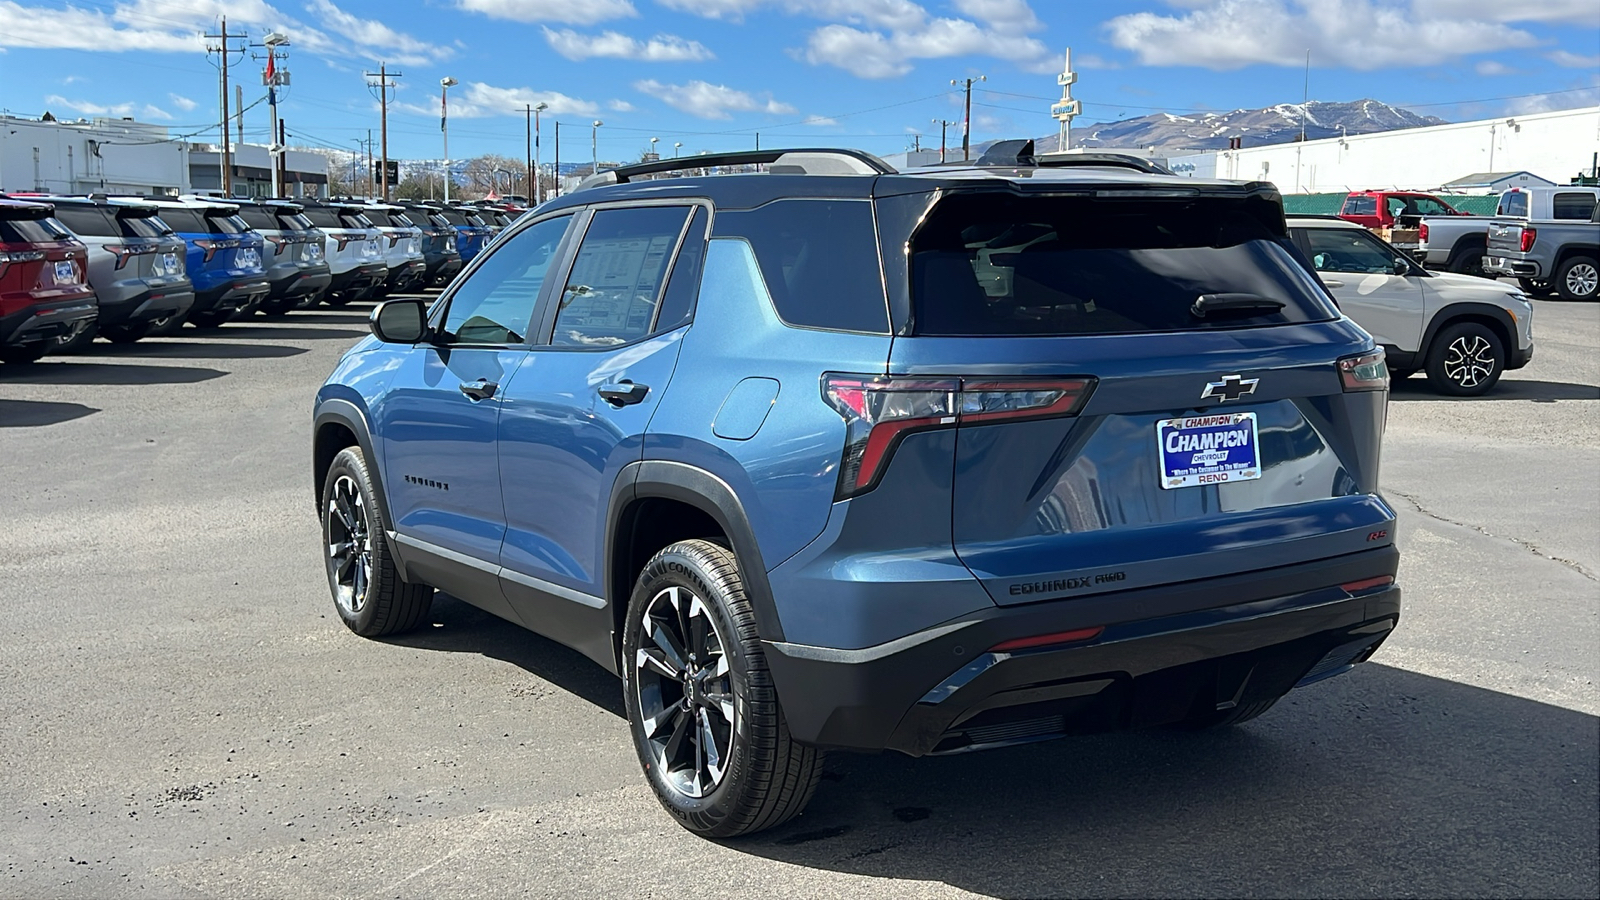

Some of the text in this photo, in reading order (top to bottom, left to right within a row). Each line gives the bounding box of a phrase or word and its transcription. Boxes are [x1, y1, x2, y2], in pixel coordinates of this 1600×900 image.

[1185, 416, 1231, 428] CHAMPION
[1166, 430, 1249, 453] CHAMPION
[1193, 453, 1226, 461] CHEVROLET
[1198, 465, 1219, 473] Customer
[1198, 474, 1229, 483] RENO
[1366, 530, 1387, 542] RS
[1009, 571, 1127, 596] EQUINOX AWD
